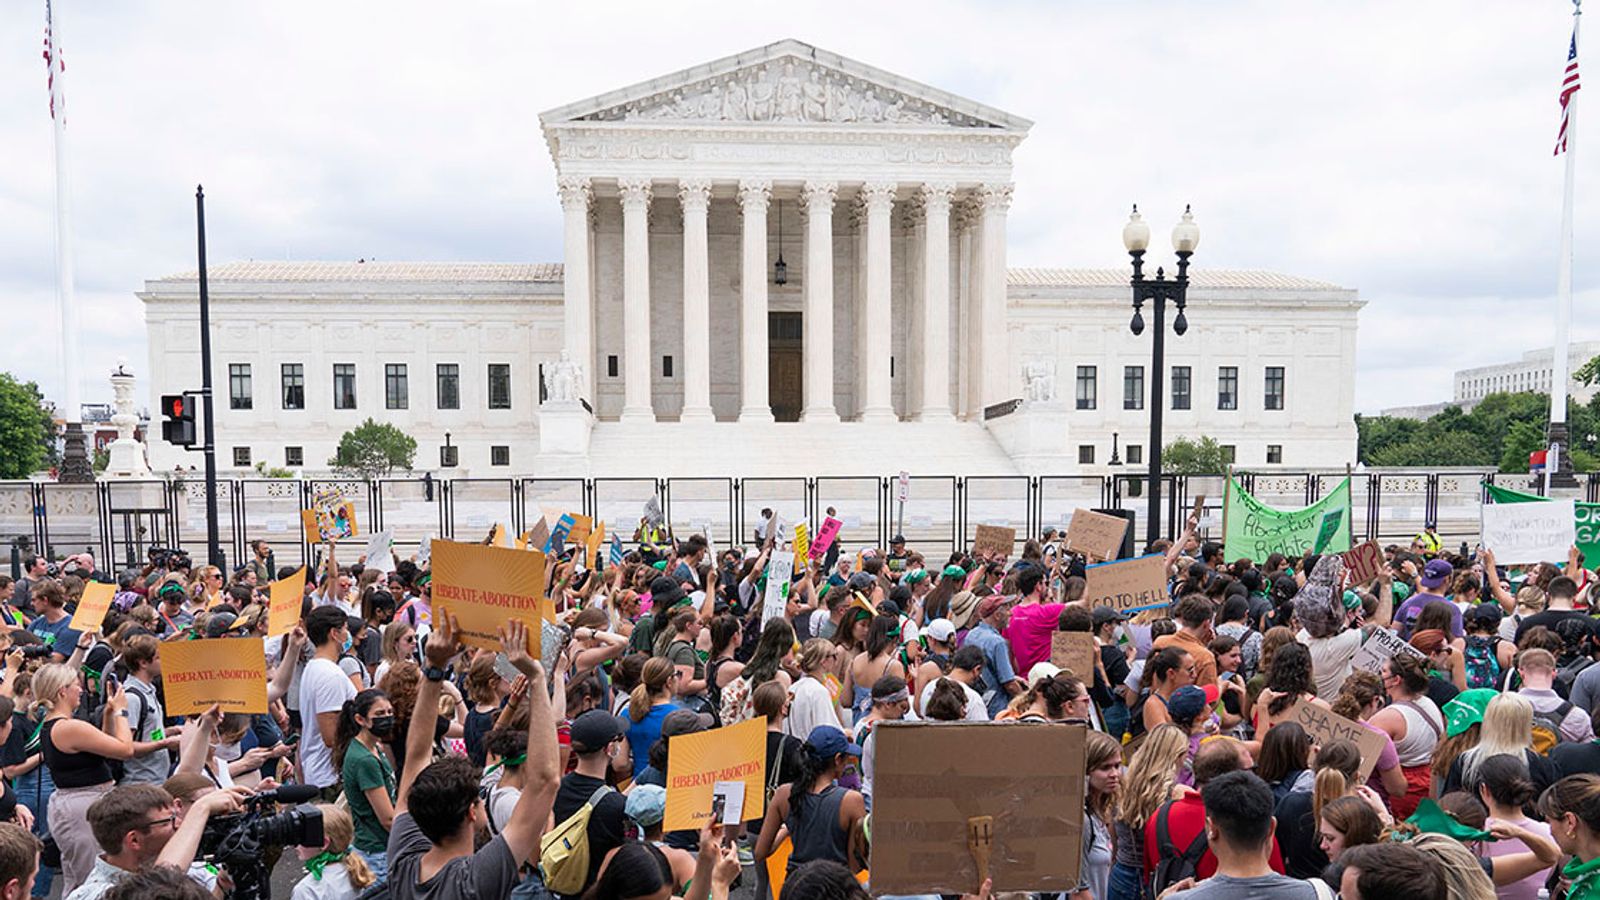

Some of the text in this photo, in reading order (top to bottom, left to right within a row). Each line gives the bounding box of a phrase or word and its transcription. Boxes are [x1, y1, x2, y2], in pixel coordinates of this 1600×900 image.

[1344, 543, 1379, 584] HY?
[436, 583, 537, 611] LIBERATE ABORTION
[1115, 593, 1133, 609] TO
[1135, 588, 1165, 606] HELL
[168, 669, 262, 684] LIBERATE ABORTION
[1298, 706, 1362, 742] SHAME
[672, 760, 761, 788] LIBERATE ABORTION
